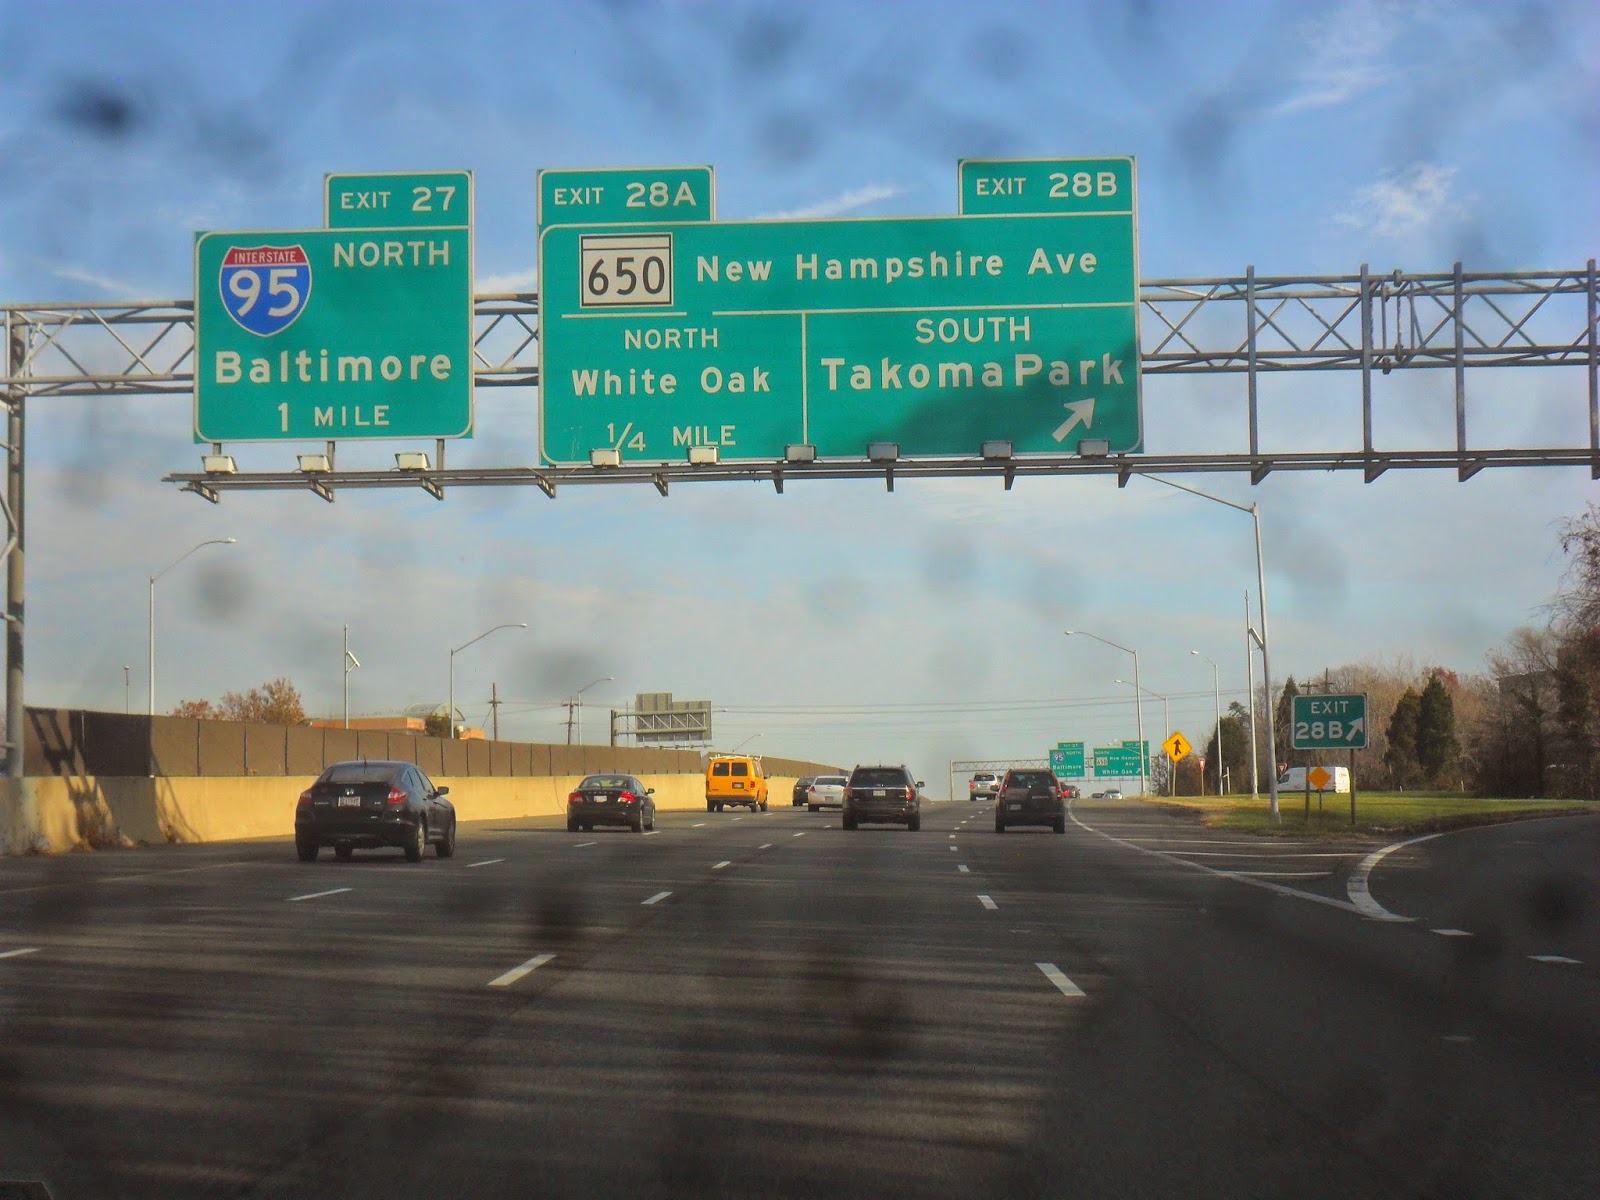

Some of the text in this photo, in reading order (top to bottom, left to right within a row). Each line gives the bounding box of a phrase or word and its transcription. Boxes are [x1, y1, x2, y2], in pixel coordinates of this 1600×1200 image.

[555, 182, 696, 207] EXIT 28A
[977, 172, 1116, 197] EXIT 28B
[342, 187, 455, 211] EXIT 27
[234, 250, 297, 263] INTERSTATE
[334, 241, 449, 267] NORTH
[698, 248, 1096, 283] New Hampshire Ave
[589, 256, 664, 295] 650
[228, 268, 300, 318] 95
[625, 328, 717, 349] NORTH
[916, 317, 1030, 343] SOUTH
[216, 349, 451, 383] Baltimore
[572, 367, 769, 396] White Oak
[278, 403, 390, 431] 1 MILE
[607, 422, 736, 452] 1/4 MILE
[1295, 701, 1349, 740] EXIT 28B
